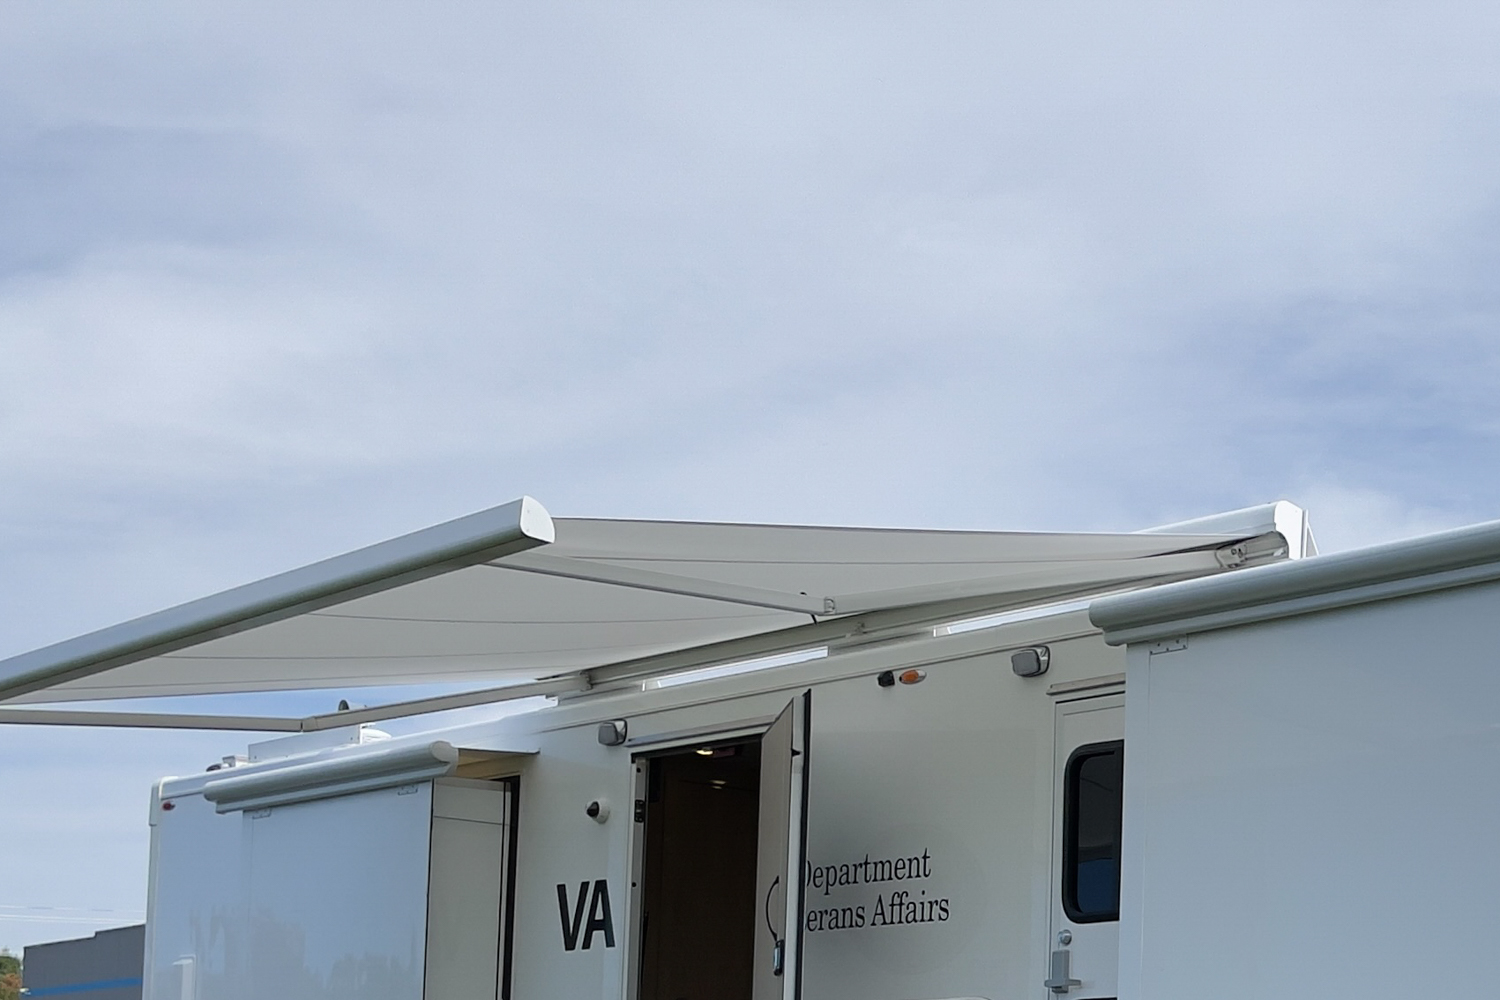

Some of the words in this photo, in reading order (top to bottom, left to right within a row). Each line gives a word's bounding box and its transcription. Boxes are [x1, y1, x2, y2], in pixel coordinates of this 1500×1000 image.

[556, 879, 616, 952] VA
[806, 904, 866, 932] erans
[870, 889, 950, 927] Affairs
